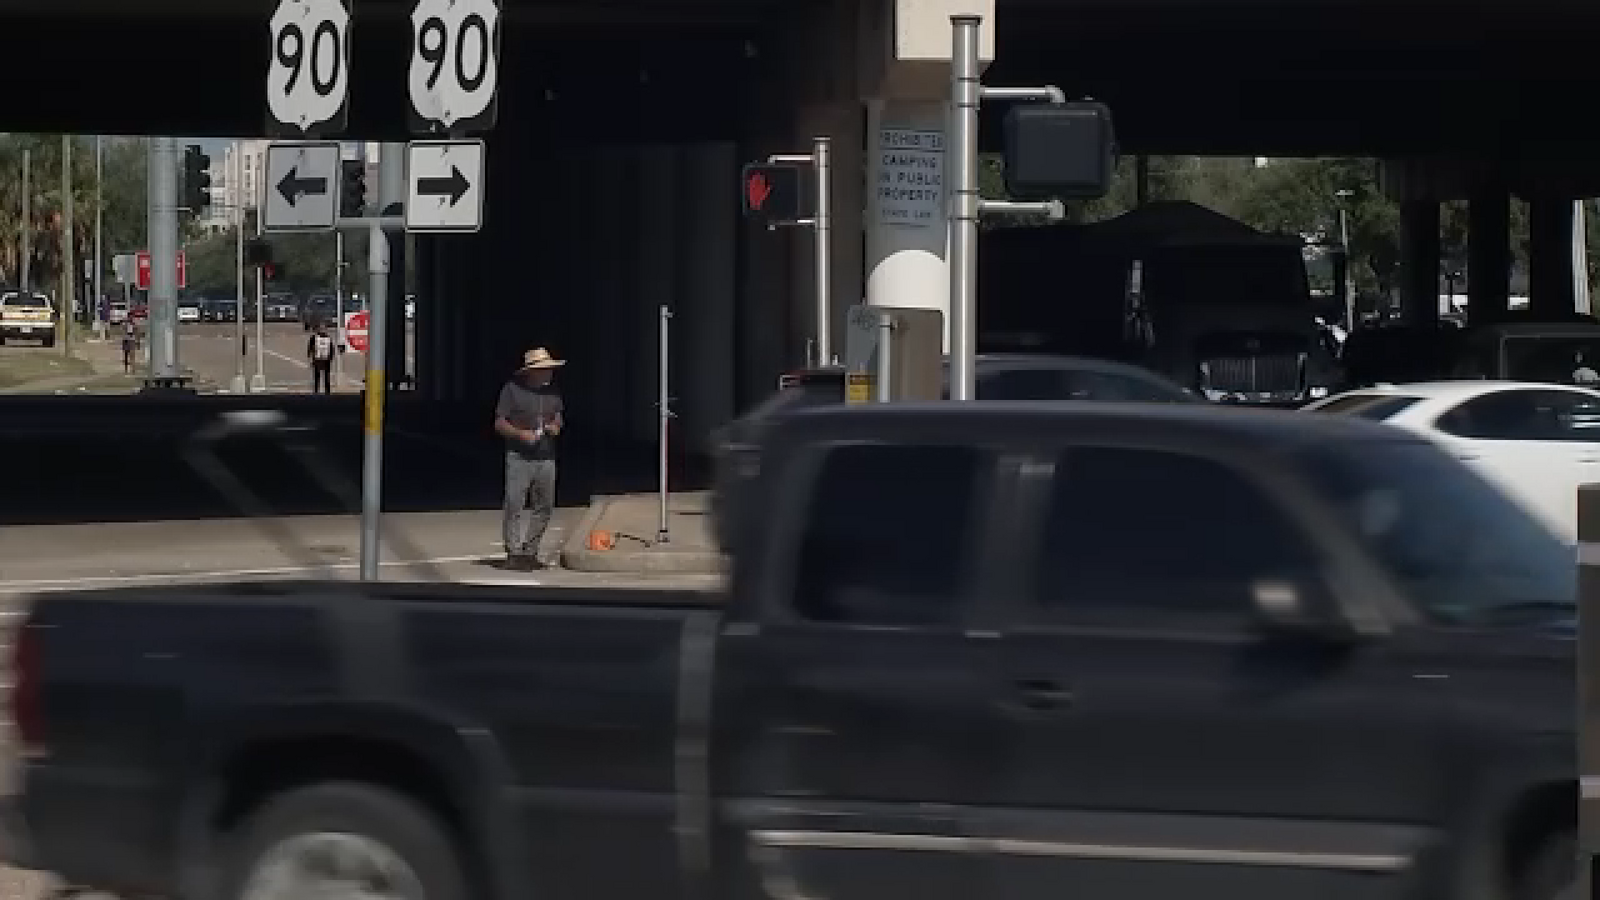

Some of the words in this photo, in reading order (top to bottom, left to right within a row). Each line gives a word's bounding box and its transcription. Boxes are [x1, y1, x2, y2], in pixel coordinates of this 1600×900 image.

[277, 20, 340, 96] 90
[419, 13, 489, 92] 90
[882, 154, 936, 168] CAMPING
[878, 171, 891, 184] IN
[897, 171, 940, 186] PUBLIC
[878, 187, 938, 202] PROPERTY
